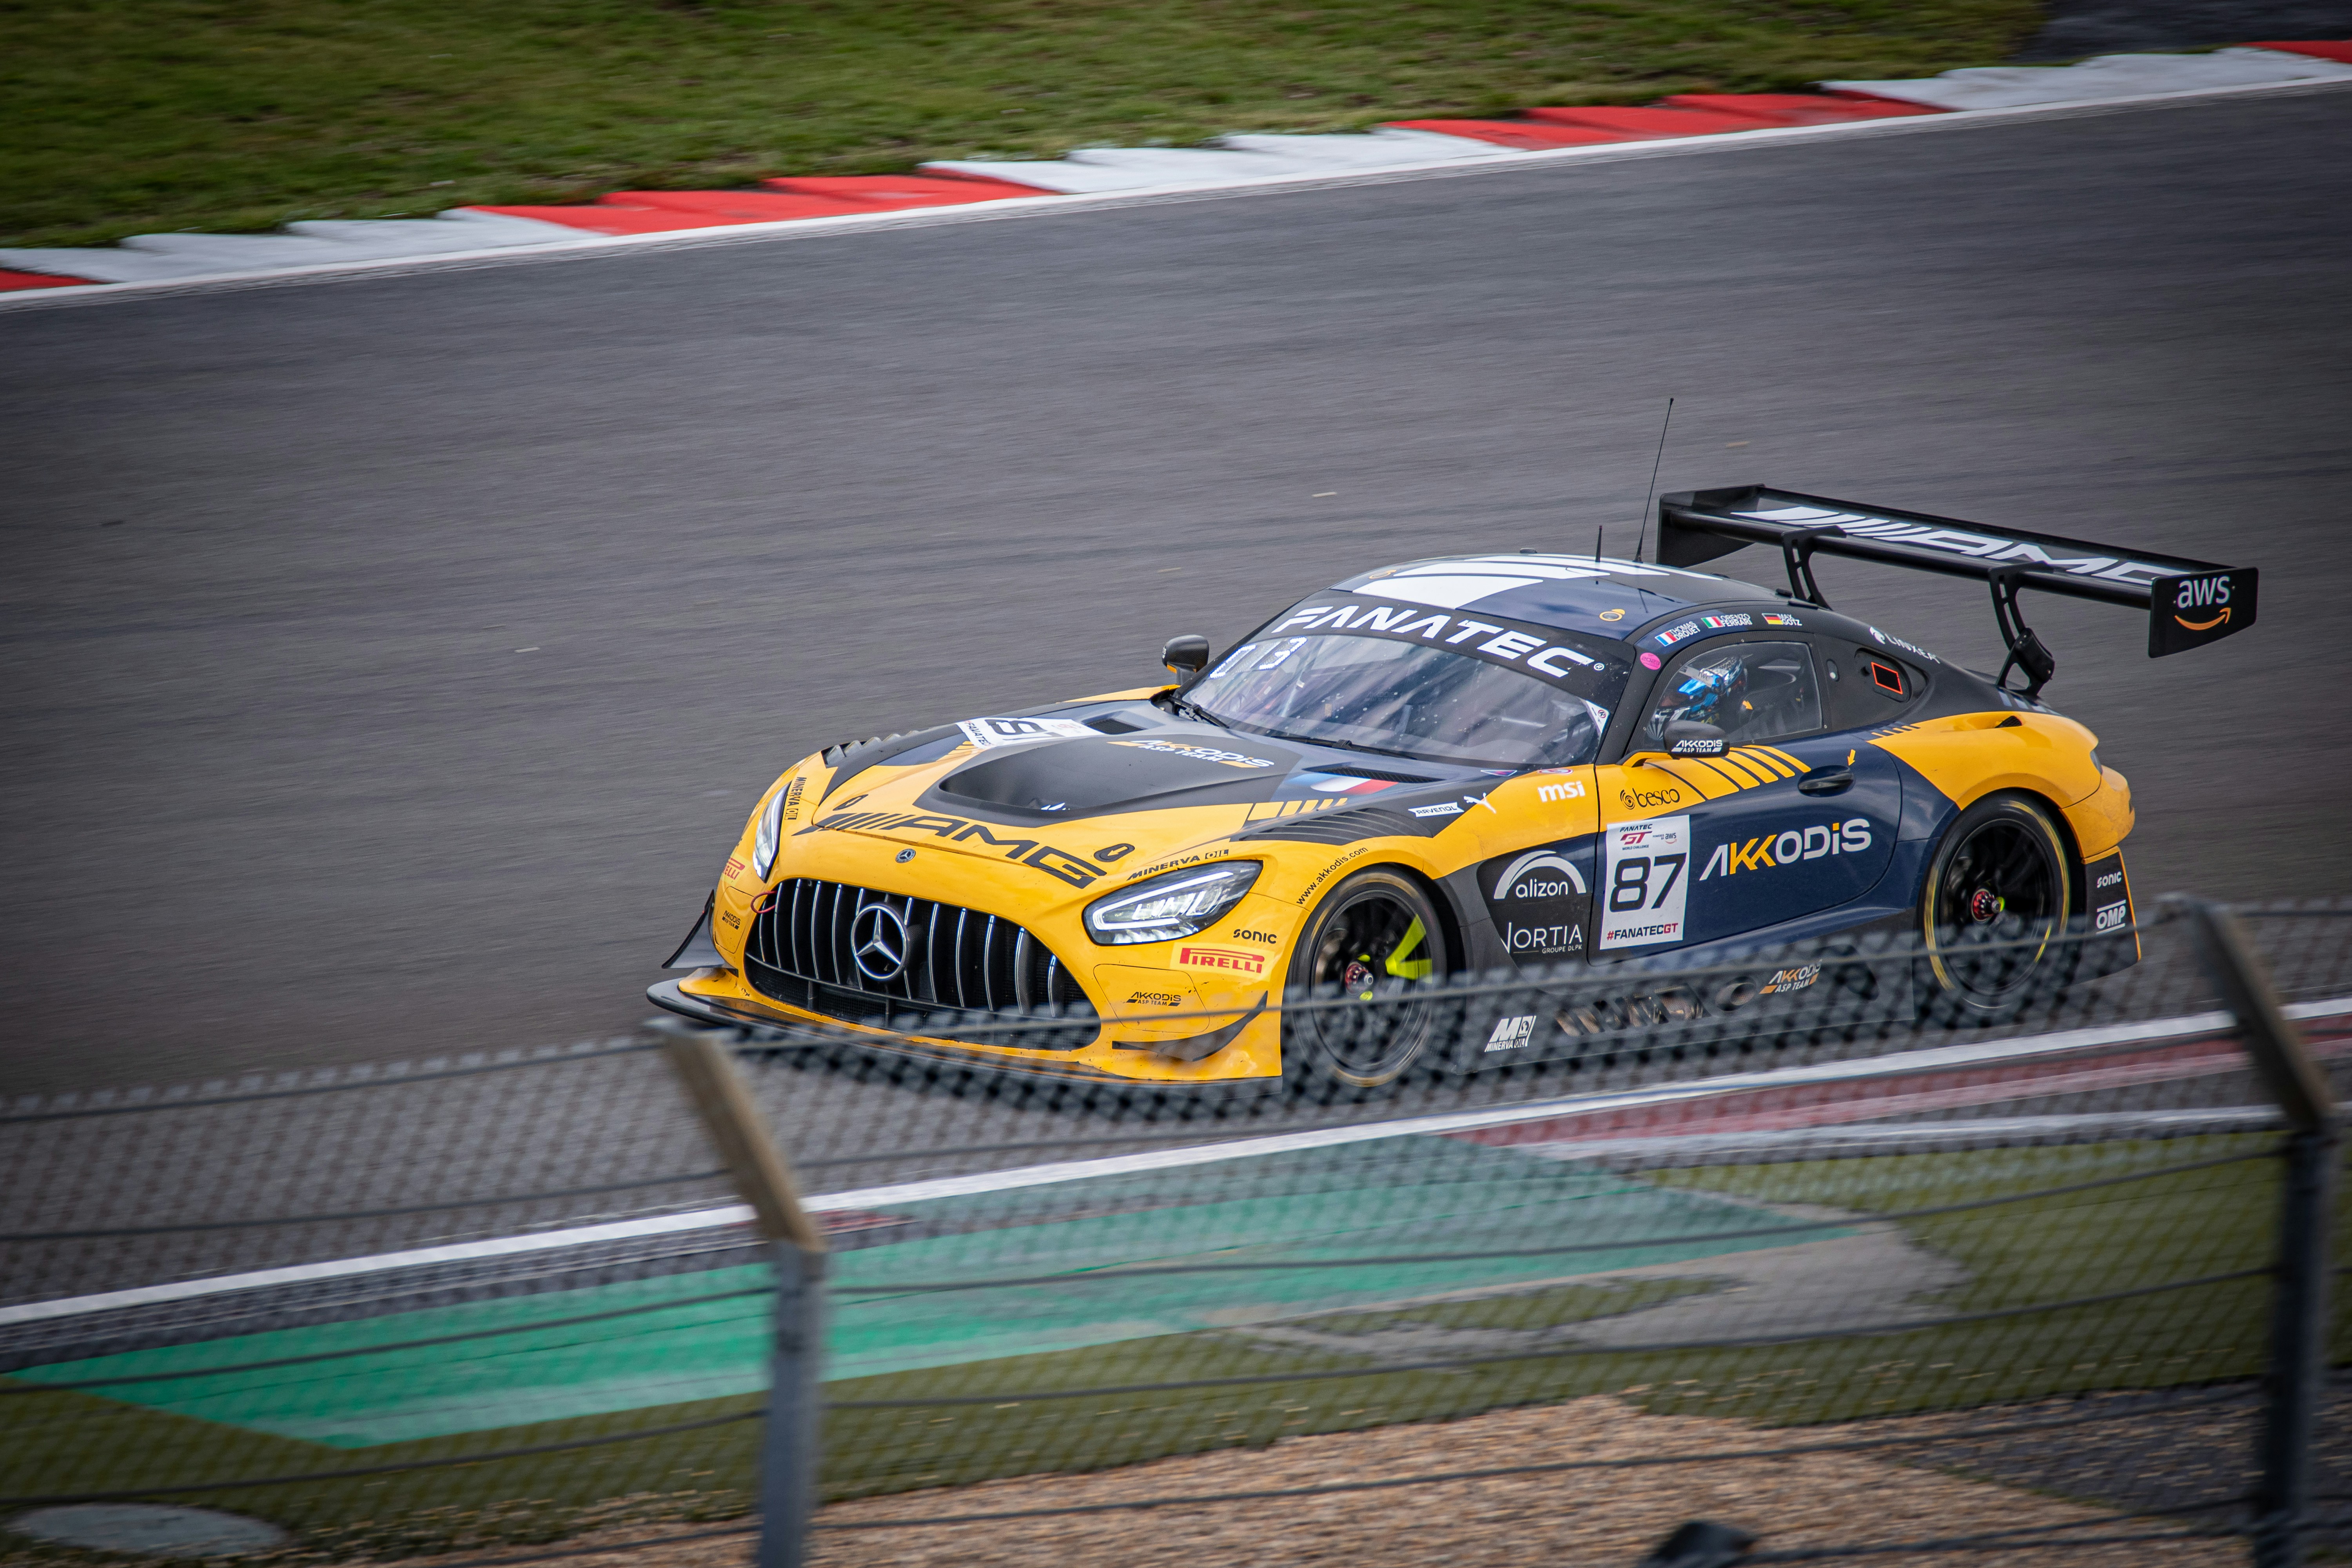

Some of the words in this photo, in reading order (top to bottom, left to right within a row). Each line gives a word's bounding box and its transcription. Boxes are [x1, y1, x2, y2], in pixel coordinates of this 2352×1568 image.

[2177, 576, 2230, 609] aws
[1669, 621, 1696, 635] THOMAS
[1673, 625, 1700, 640] DROUET
[1175, 750, 1223, 762] TEAM
[788, 777, 807, 806] MINERVA
[1537, 781, 1585, 802] msi
[1635, 788, 1681, 808] besco
[784, 808, 799, 820] OIL
[1416, 806, 1457, 815] RAVENOL
[1620, 824, 1653, 832] FANATEC
[1620, 831, 1653, 845] GT
[1127, 855, 1200, 880] MINERVA
[1205, 849, 1229, 860] OIL
[1296, 846, 1368, 906] www.akkodis.com
[1609, 852, 1687, 913] 87
[1515, 878, 1568, 898] alizon
[2096, 906, 2126, 929] OMP
[1606, 922, 1679, 941] #FANATECGT
[1180, 948, 1265, 974] PIRELLI
[1775, 982, 1791, 993] ASP
[1793, 978, 1809, 990] TEAM
[1484, 1040, 1514, 1052] MINERVA
[1514, 1038, 1525, 1048] OIL
